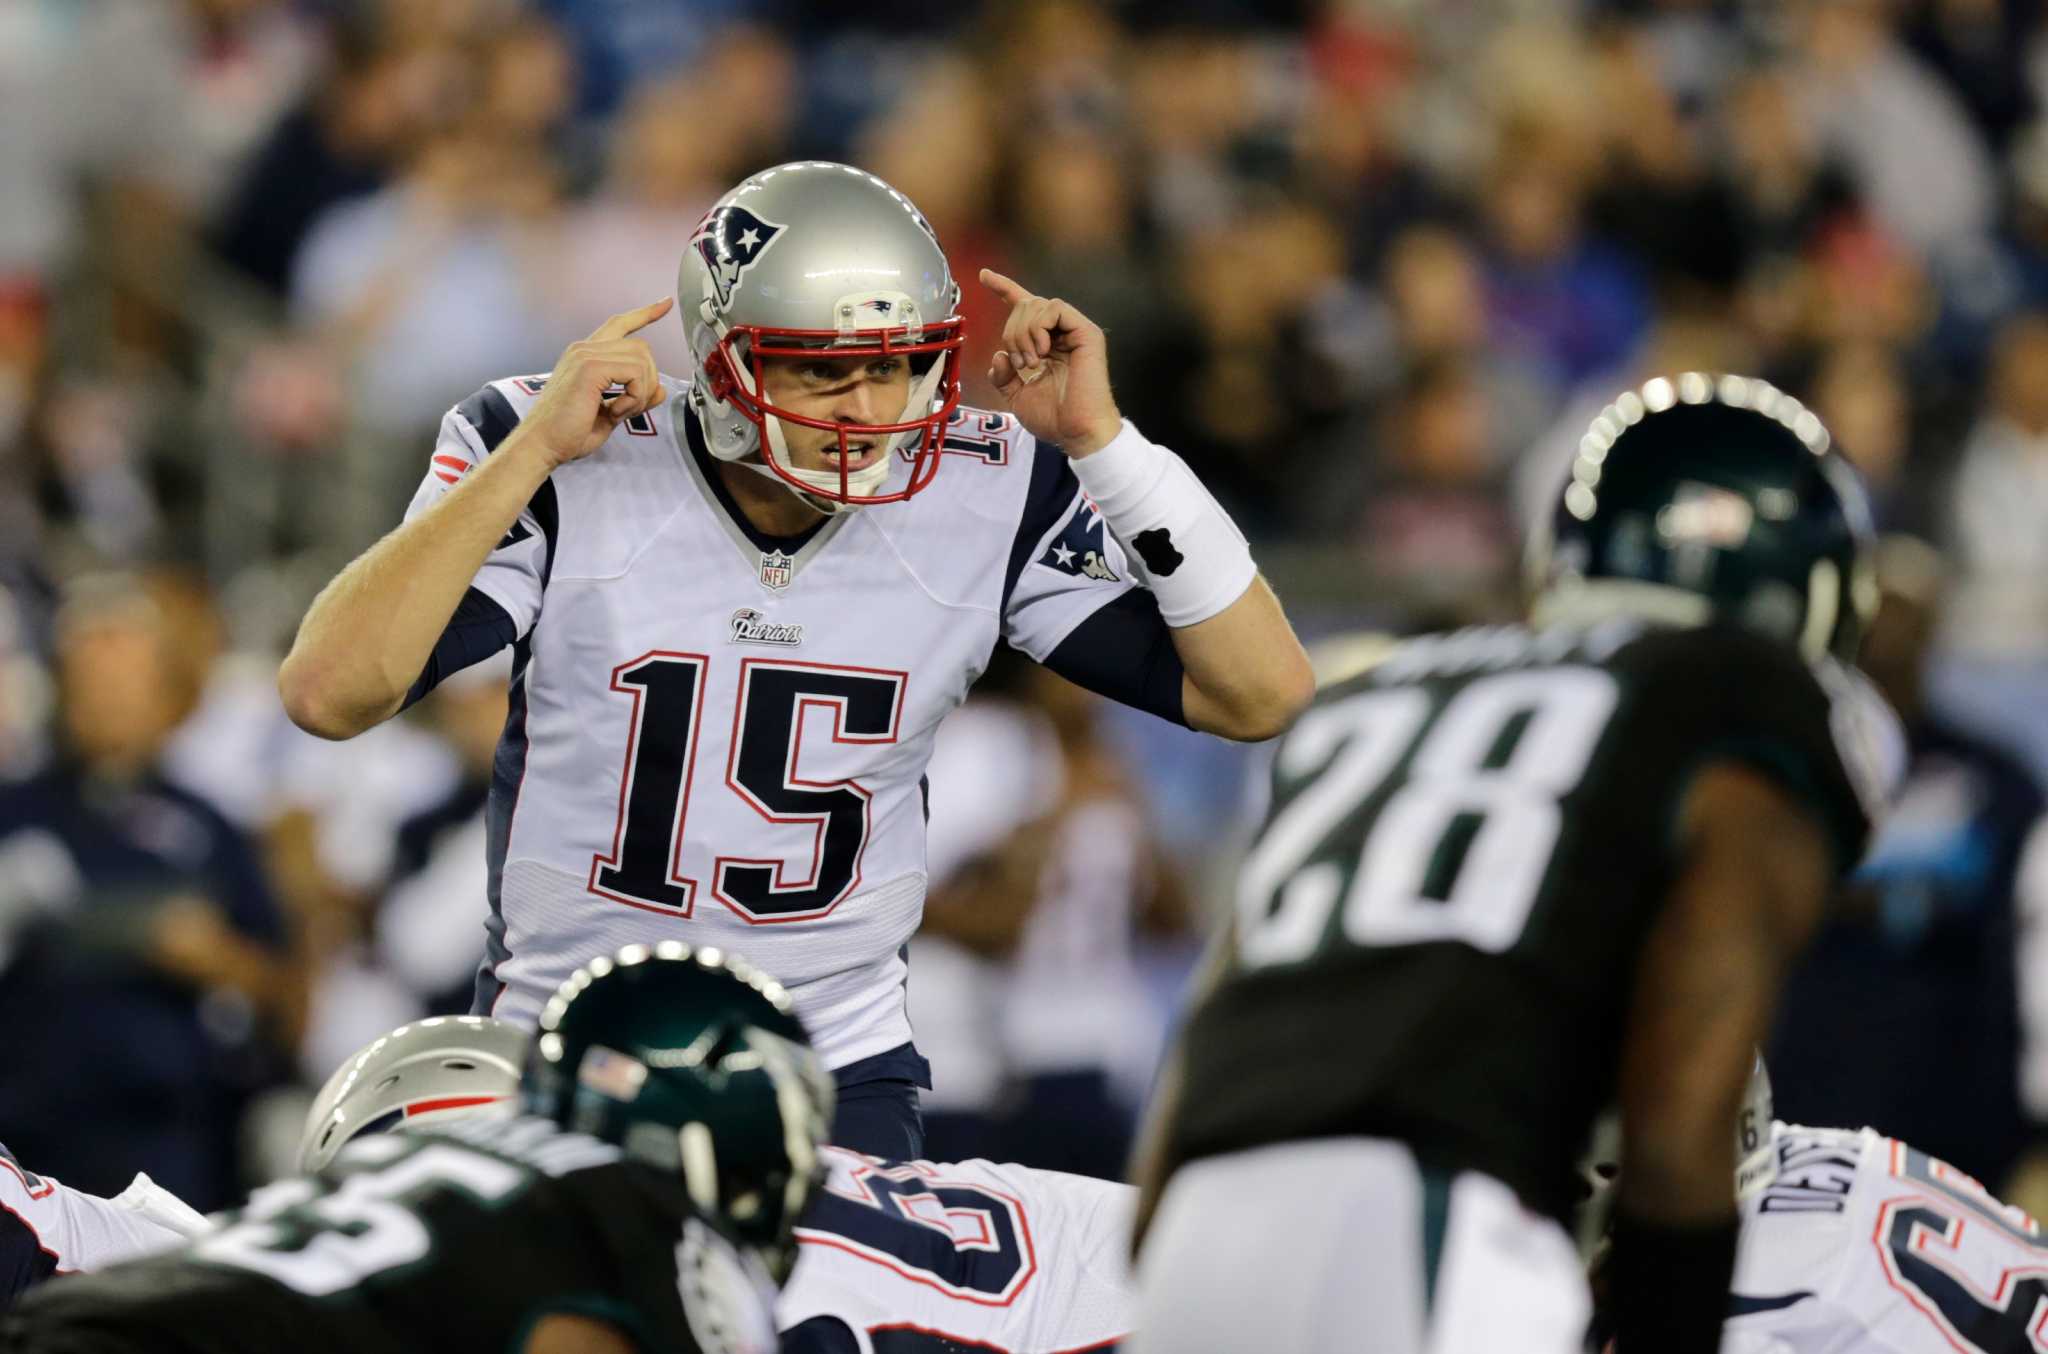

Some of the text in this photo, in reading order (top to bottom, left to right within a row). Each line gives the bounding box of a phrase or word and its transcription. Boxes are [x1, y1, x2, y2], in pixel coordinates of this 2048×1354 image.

[730, 617, 803, 647] Patriots
[763, 567, 788, 586] NFL
[587, 650, 908, 924] 15
[1237, 662, 1620, 969] 28
